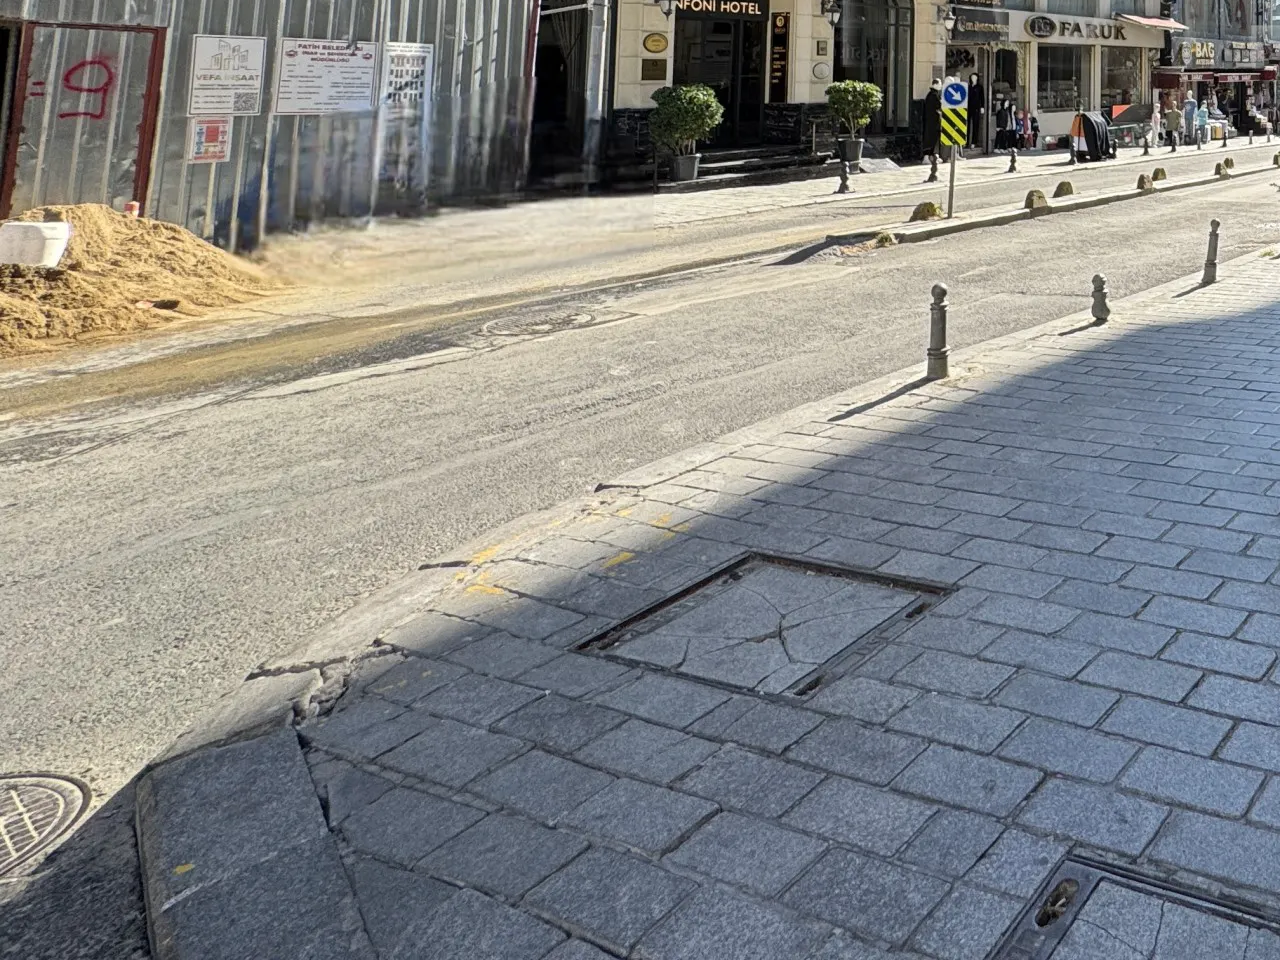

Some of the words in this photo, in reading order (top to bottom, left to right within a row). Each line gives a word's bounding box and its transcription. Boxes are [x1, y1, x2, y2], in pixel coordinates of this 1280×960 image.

[720, 0, 762, 15] HOTEL
[1058, 21, 1127, 40] FARUK
[1196, 42, 1215, 58] BAG
